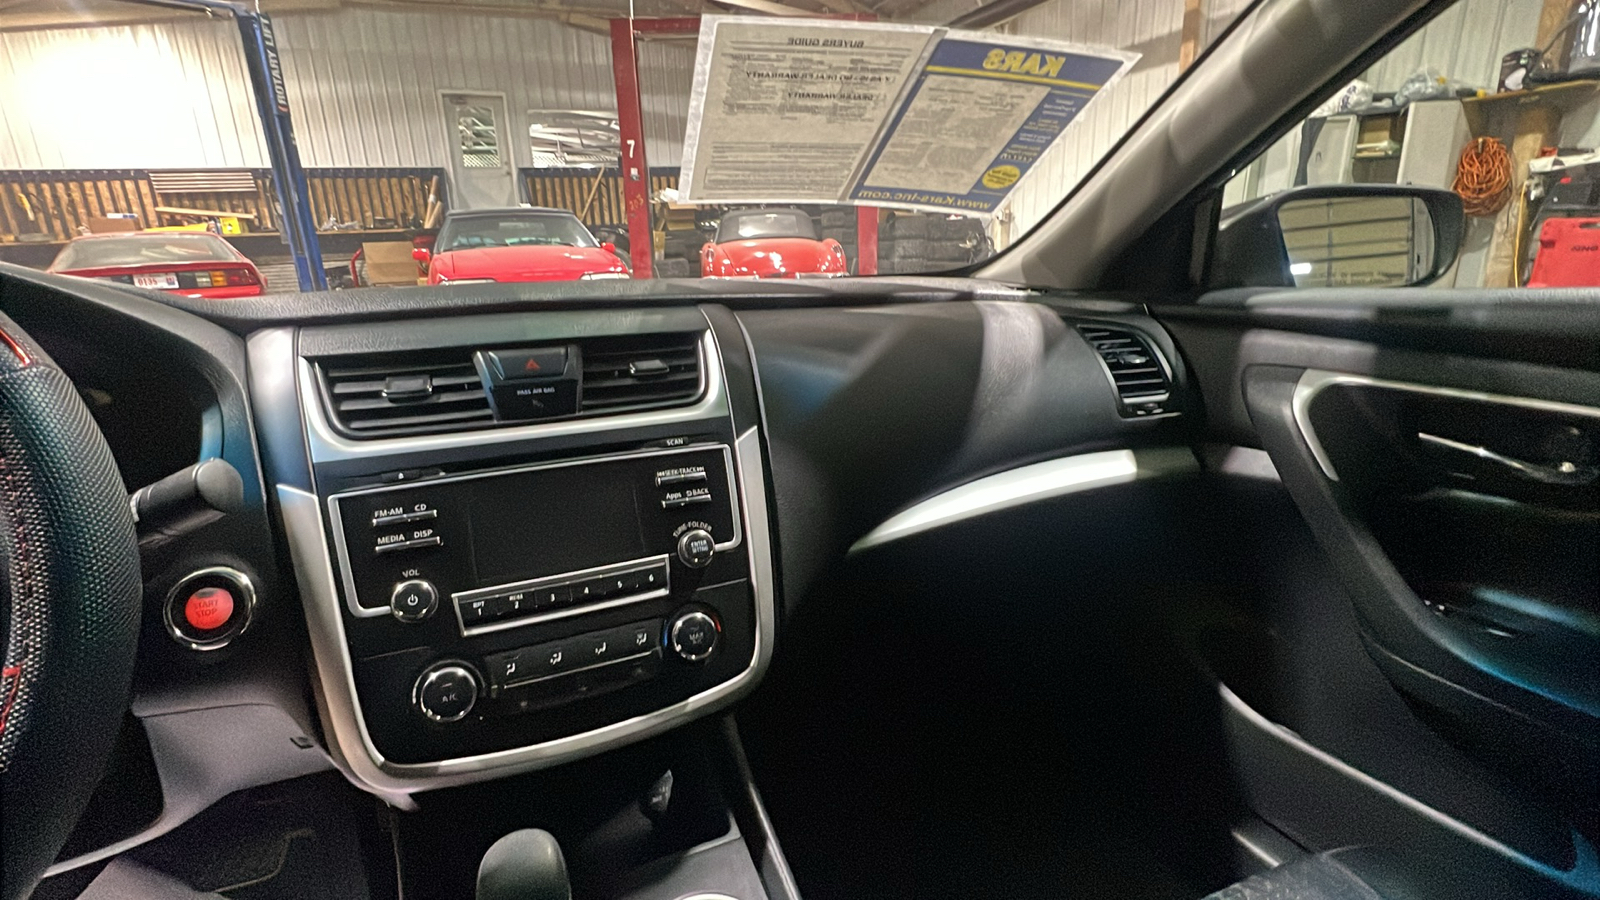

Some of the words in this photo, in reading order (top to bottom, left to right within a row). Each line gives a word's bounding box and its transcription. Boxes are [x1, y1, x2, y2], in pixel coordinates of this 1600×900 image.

[260, 15, 275, 47] LIFT
[267, 49, 288, 105] ROTARY
[626, 139, 635, 158] 7
[666, 438, 684, 446] SCAN
[665, 492, 683, 501] Apps
[692, 487, 710, 496] BACK
[414, 503, 427, 512] CD
[377, 533, 406, 545] MEDIA
[413, 529, 434, 539] DISP
[402, 568, 420, 578] VOL
[194, 599, 219, 609] START
[195, 608, 218, 618] STOP
